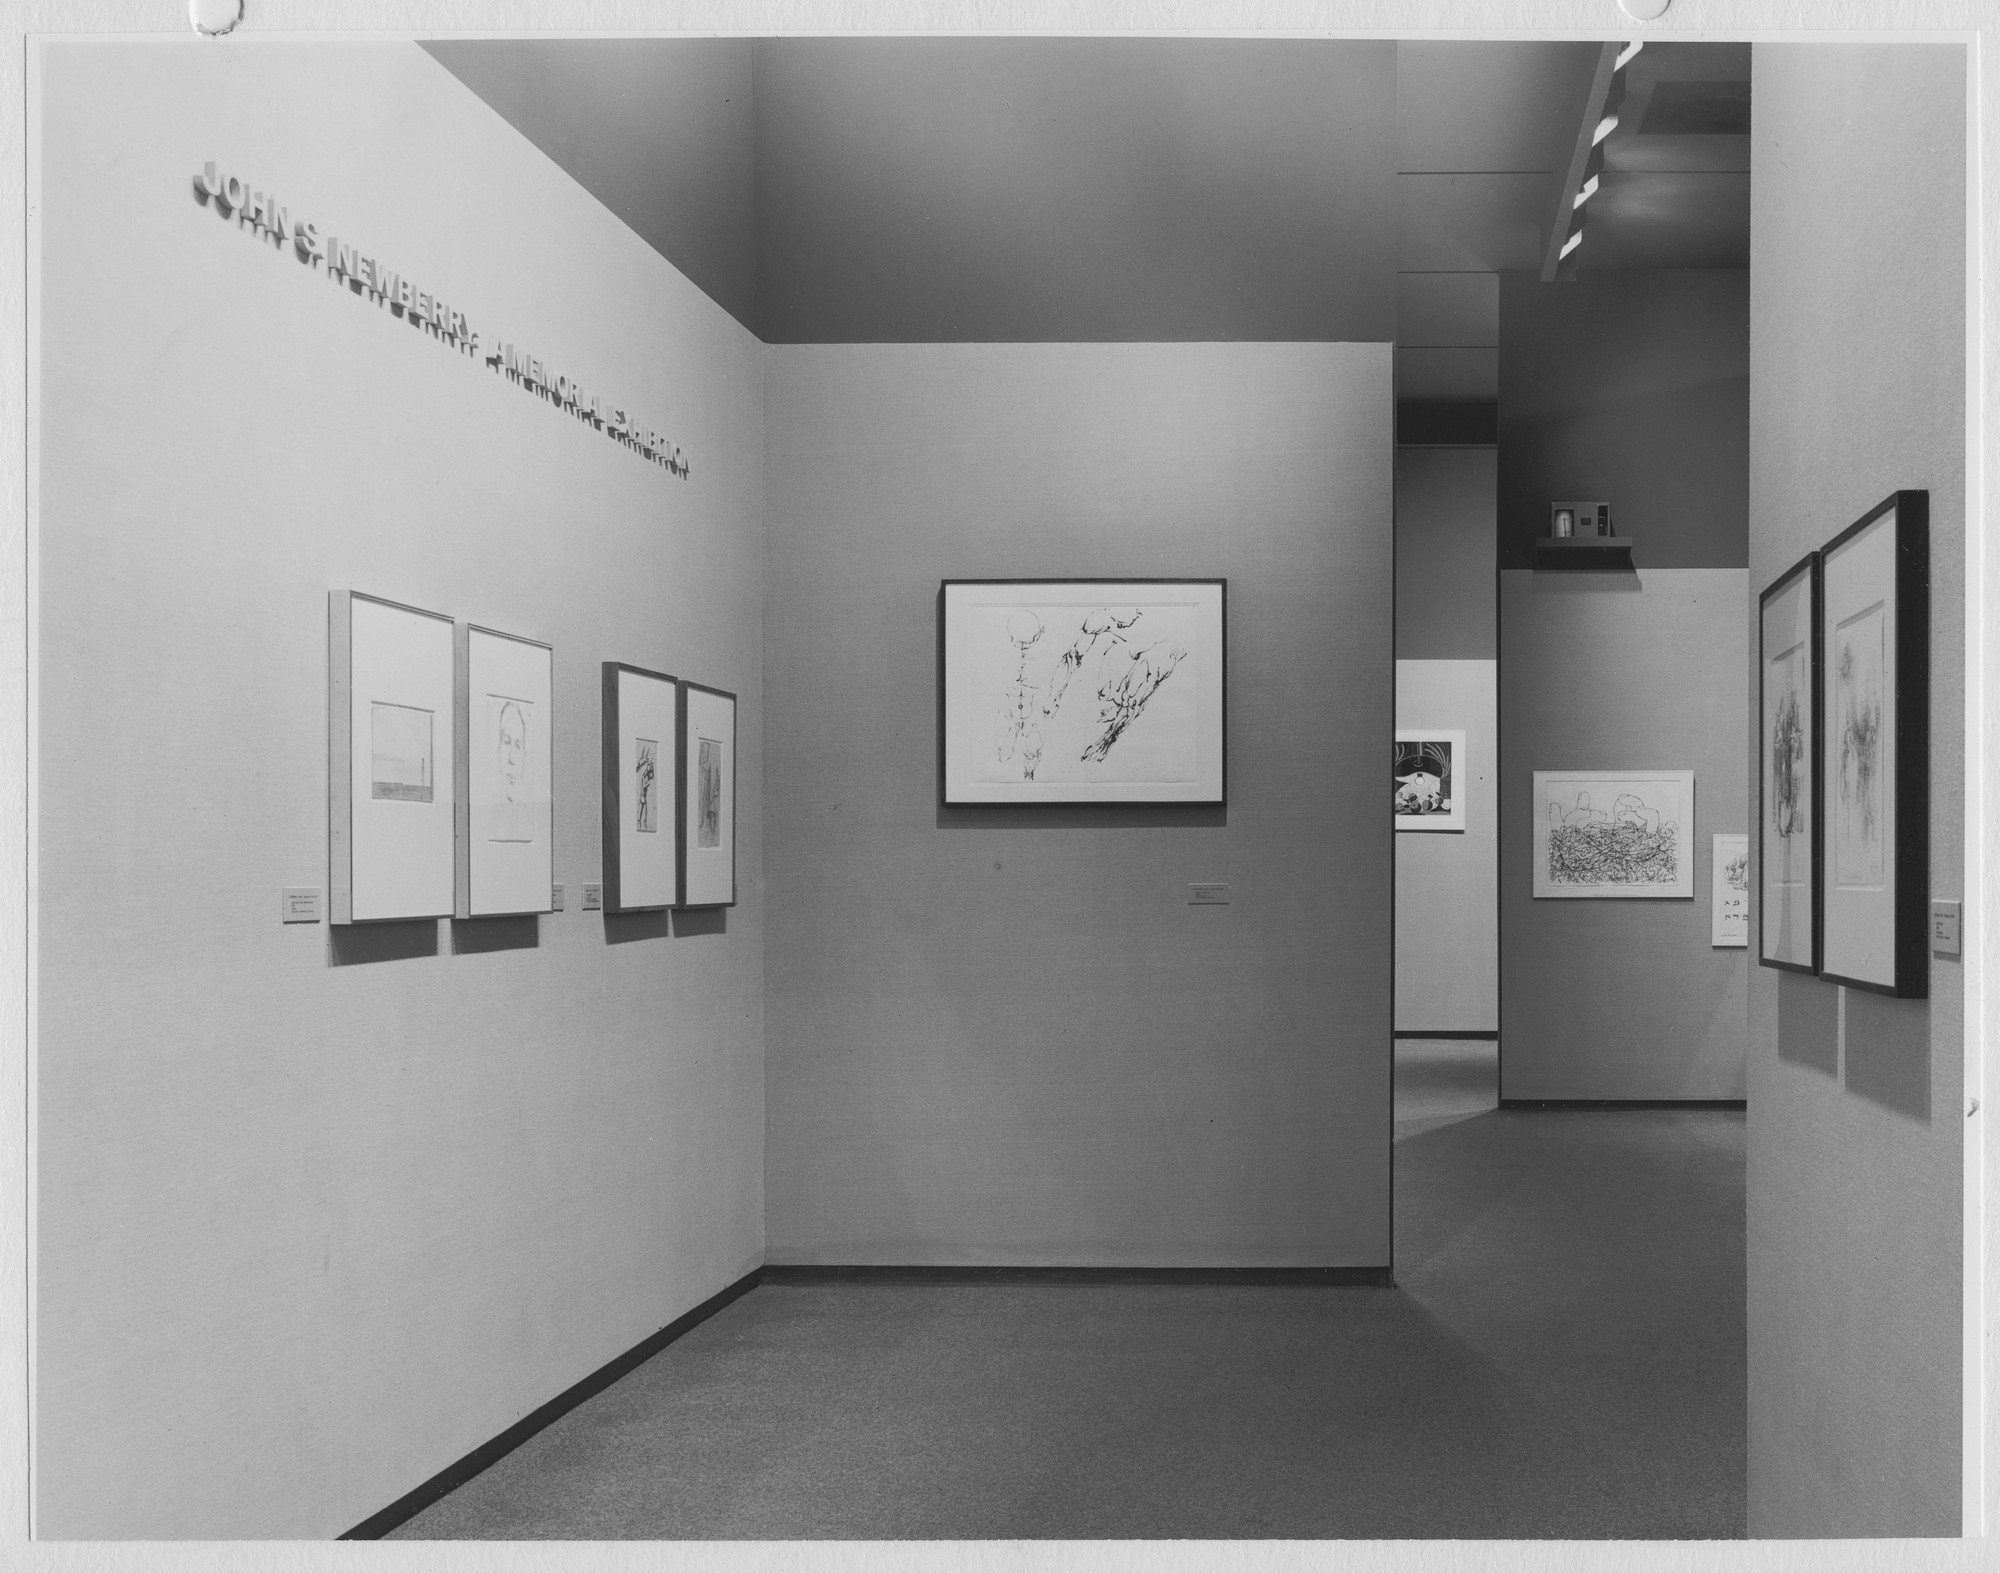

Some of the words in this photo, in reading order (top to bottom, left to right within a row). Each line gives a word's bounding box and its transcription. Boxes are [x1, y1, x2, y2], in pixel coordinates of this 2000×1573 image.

[193, 161, 290, 243] JOHN
[486, 334, 506, 366] A
[506, 344, 606, 424] MEMORIAL
[607, 405, 692, 475] EXHIBITION
